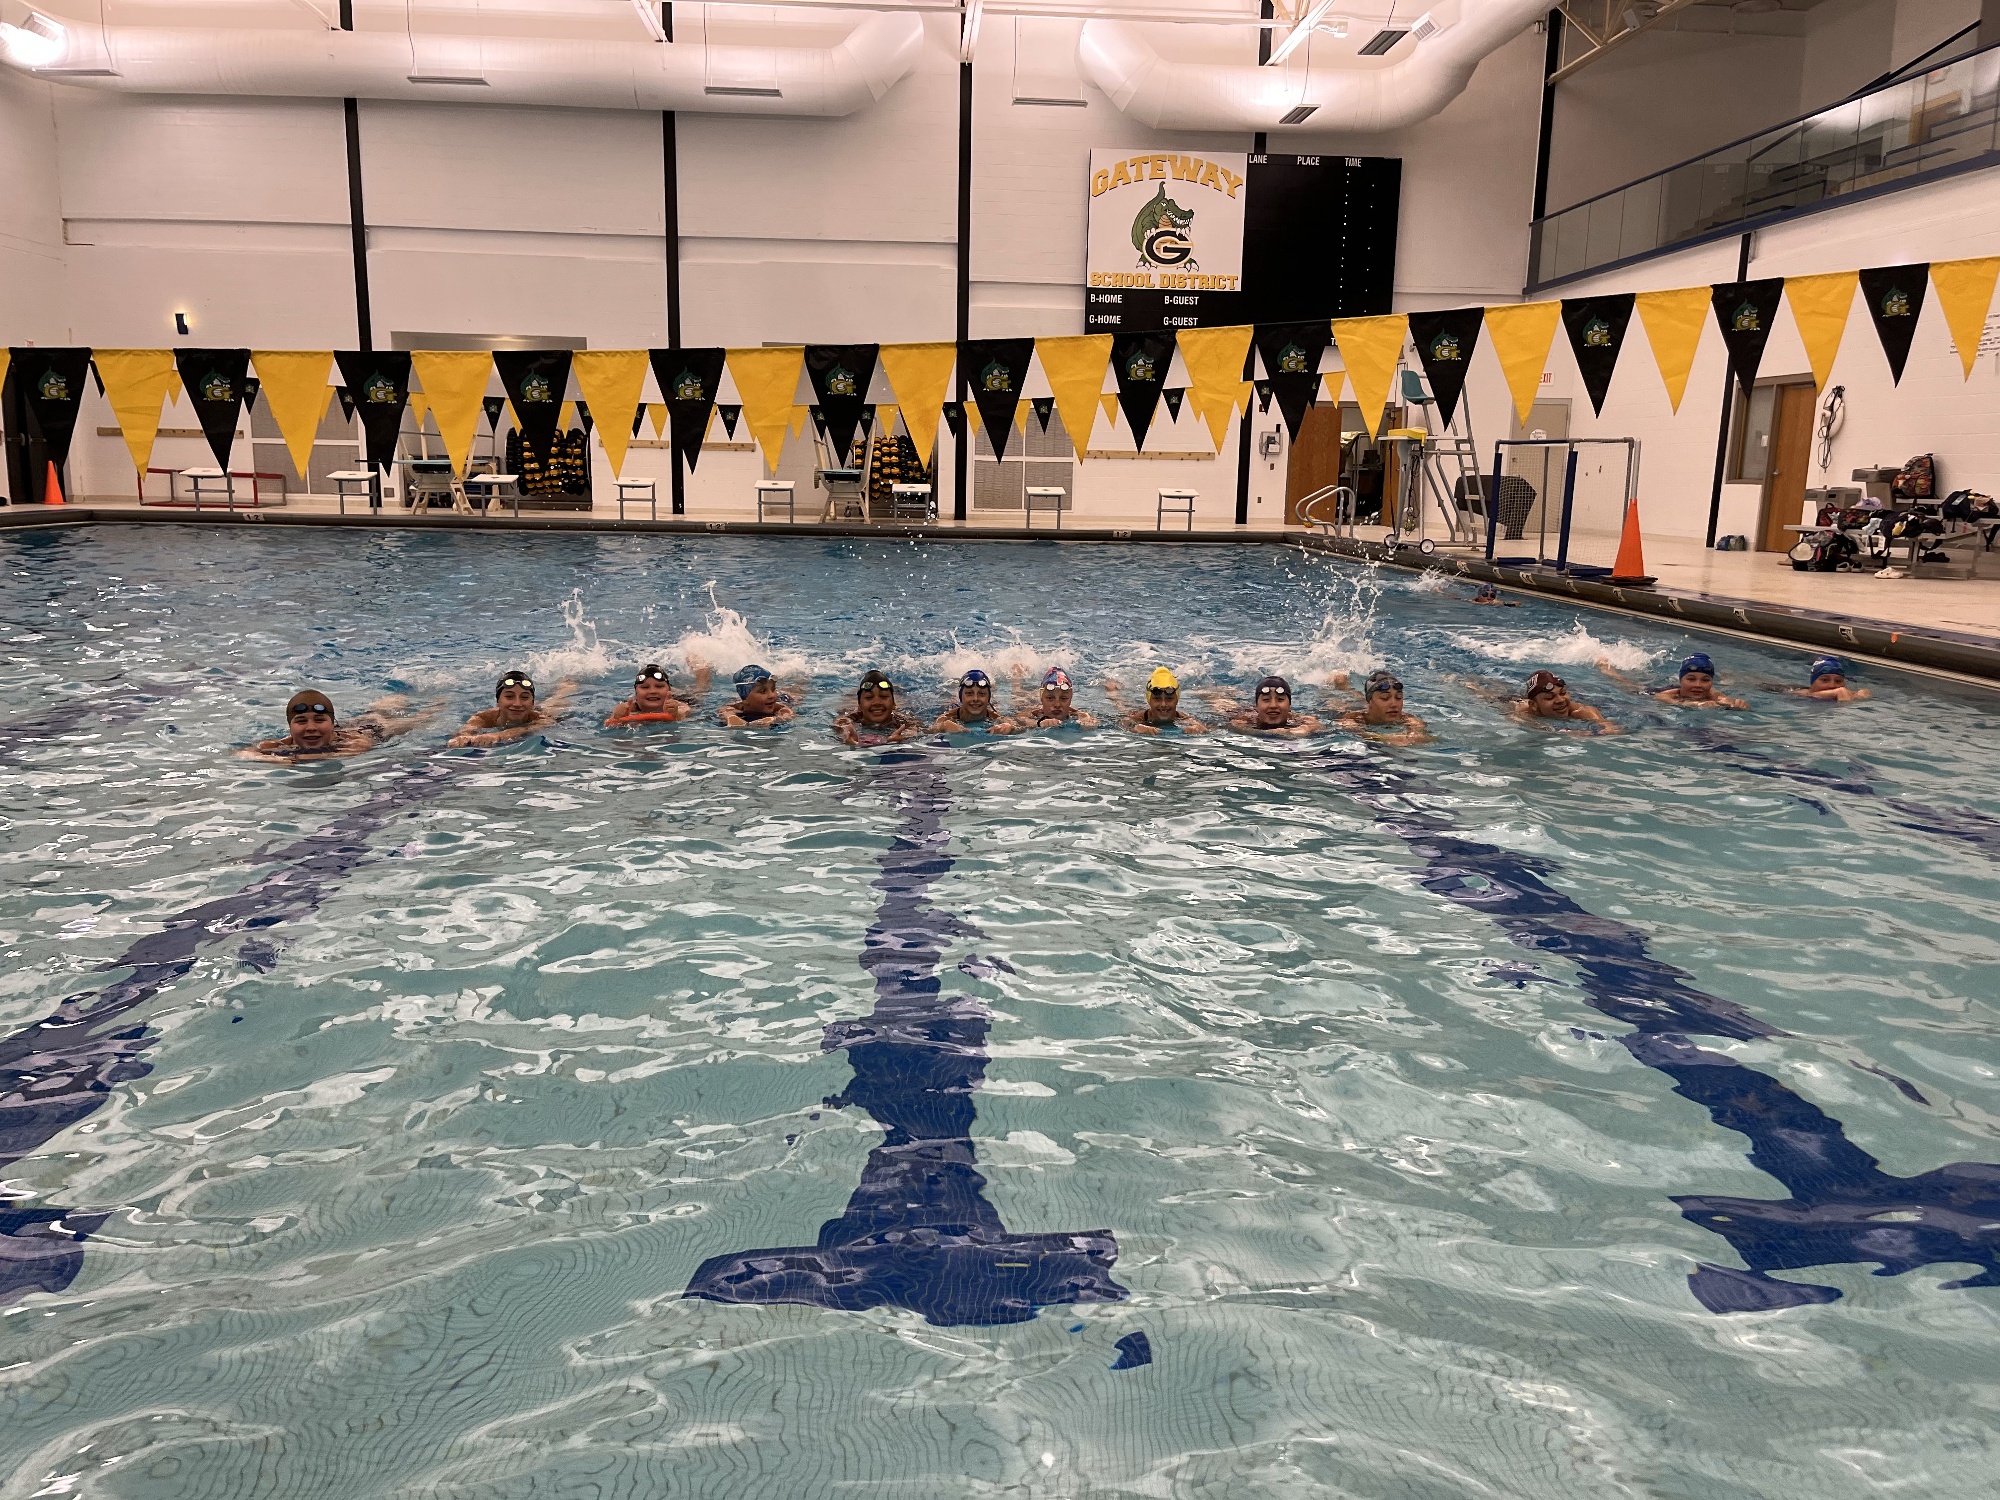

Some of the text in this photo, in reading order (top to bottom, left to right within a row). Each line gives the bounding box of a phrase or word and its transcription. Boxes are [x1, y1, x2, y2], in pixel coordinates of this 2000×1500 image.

[1248, 154, 1362, 167] LANE PLACE TIME
[1092, 154, 1244, 199] GATEWAY
[1144, 229, 1193, 266] G
[1089, 271, 1239, 290] SCHOOL DISTRICT
[1090, 294, 1200, 306] B-HOME B-GUEST
[1088, 314, 1199, 326] G-HOME G-GUEST
